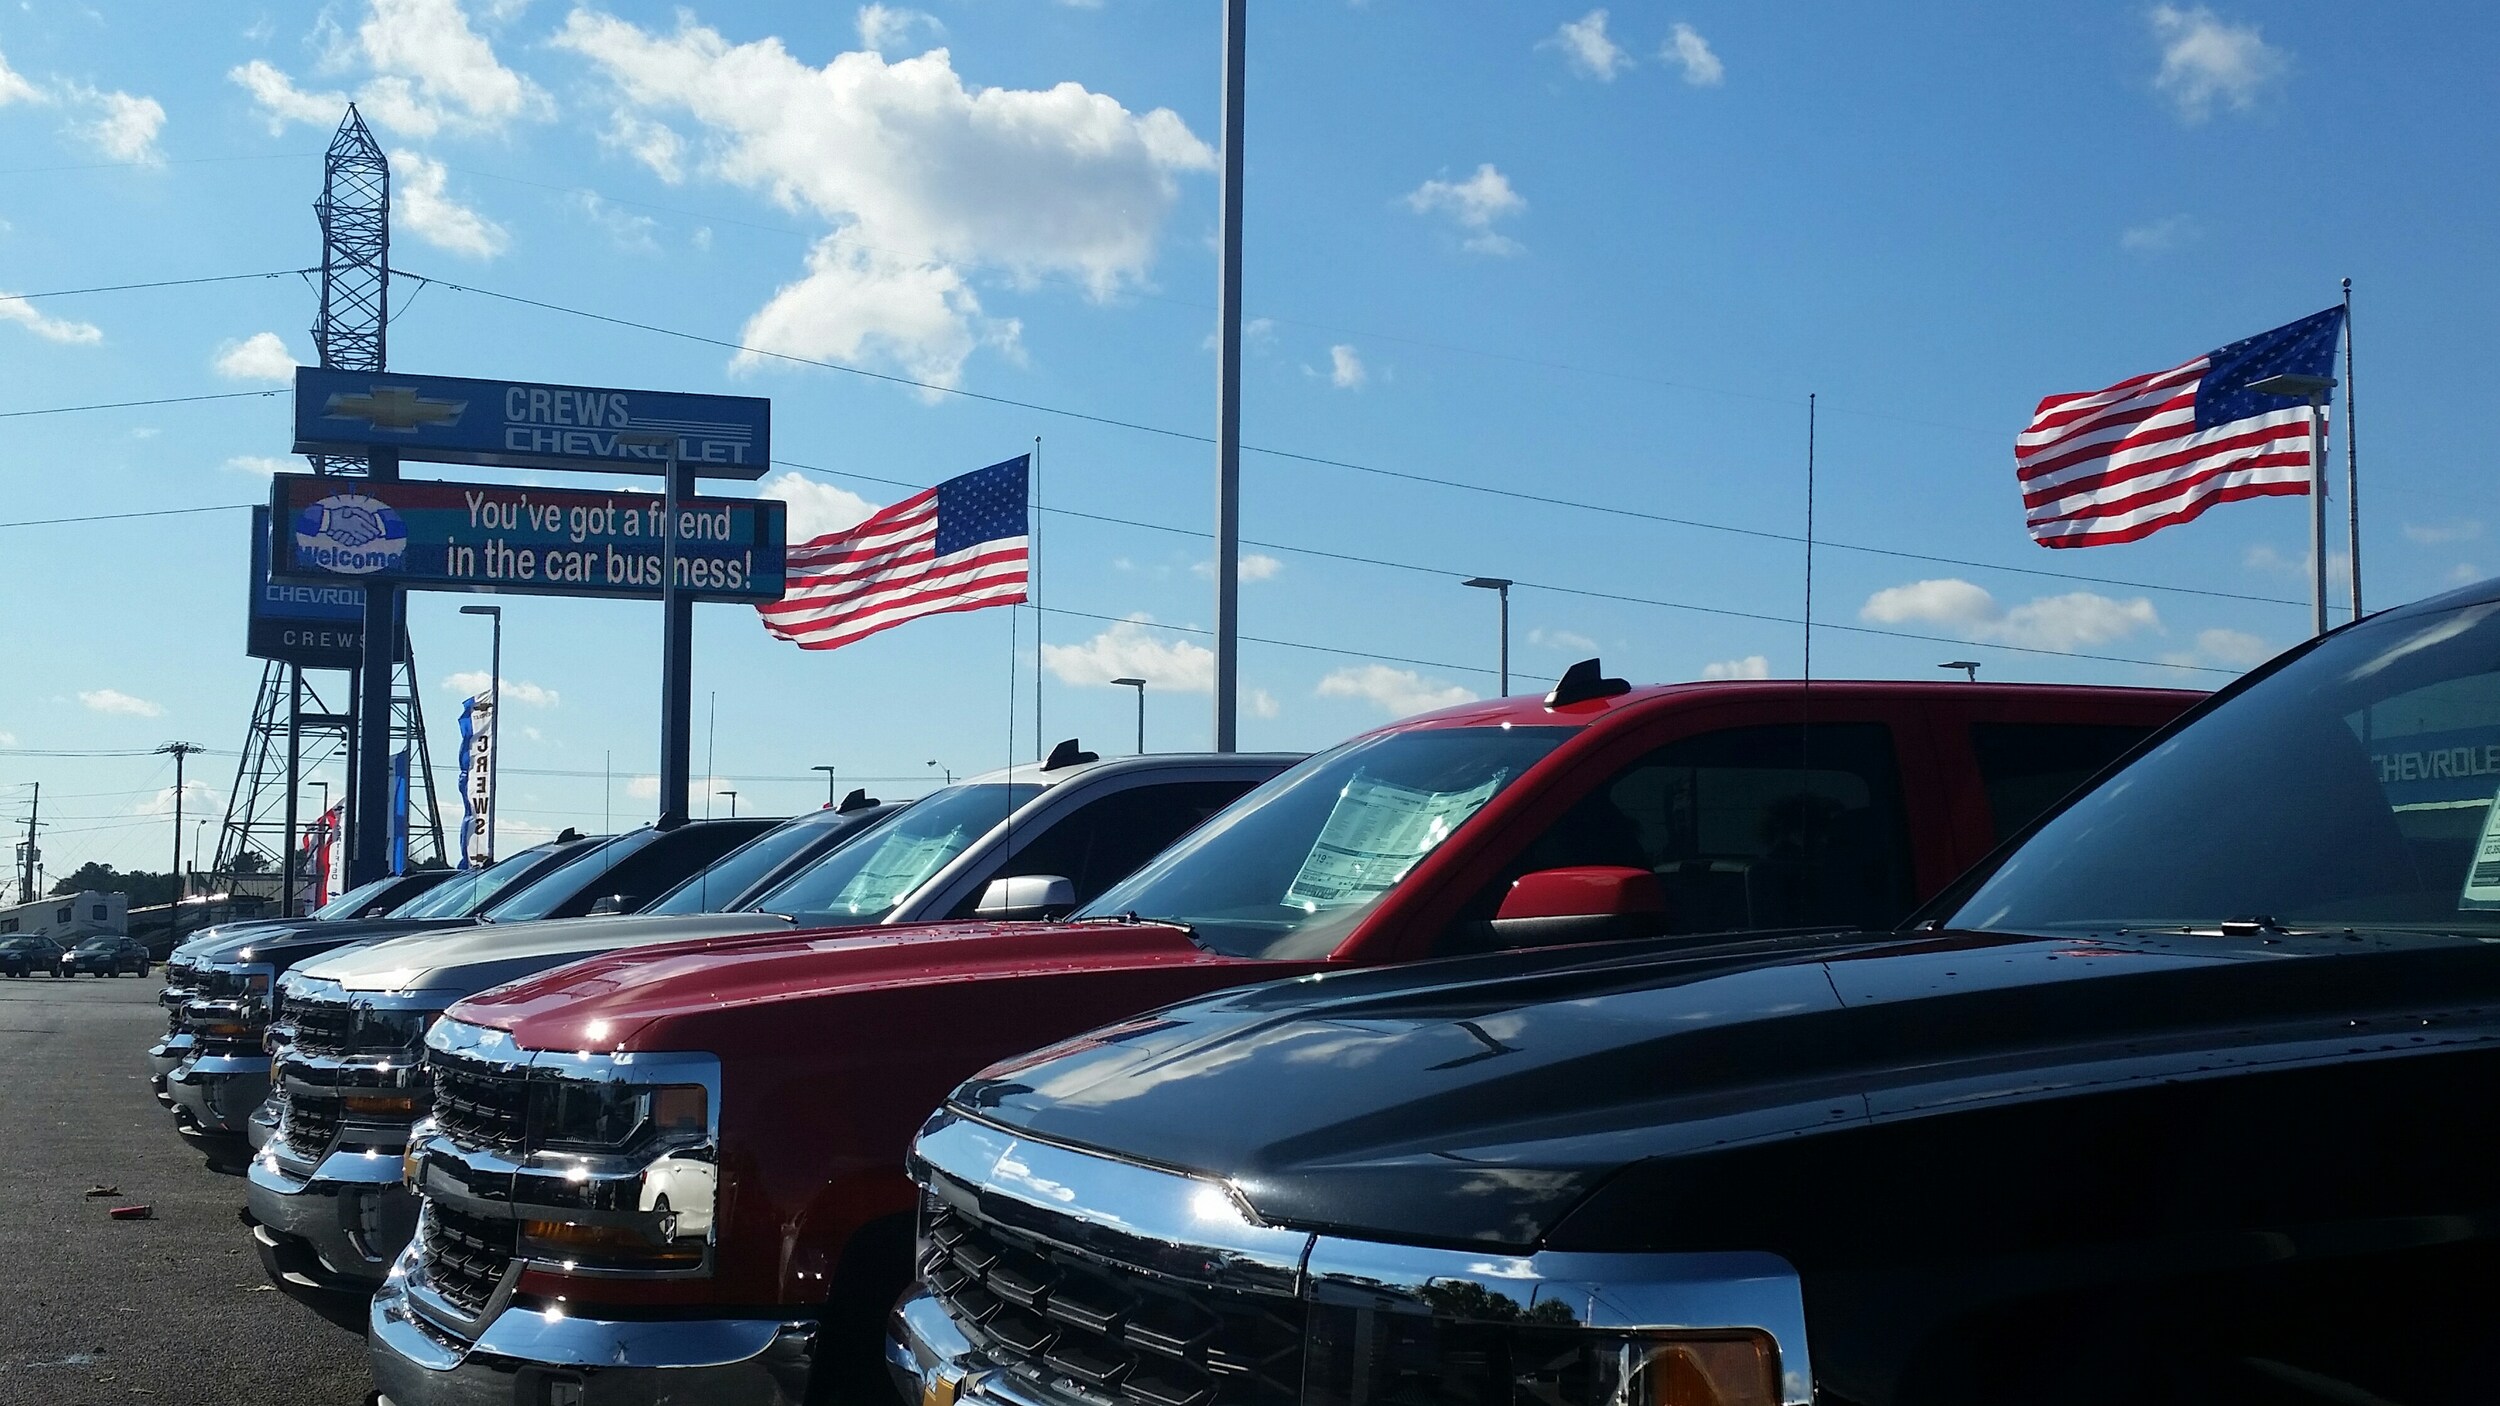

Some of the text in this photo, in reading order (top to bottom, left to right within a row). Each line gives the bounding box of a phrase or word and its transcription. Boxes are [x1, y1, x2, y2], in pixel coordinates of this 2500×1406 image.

[505, 387, 629, 428] CREWS
[465, 490, 731, 543] You've got a frend
[297, 546, 404, 569] Welcome
[448, 536, 752, 589] in the car busness!
[266, 585, 365, 606] CHEVROL
